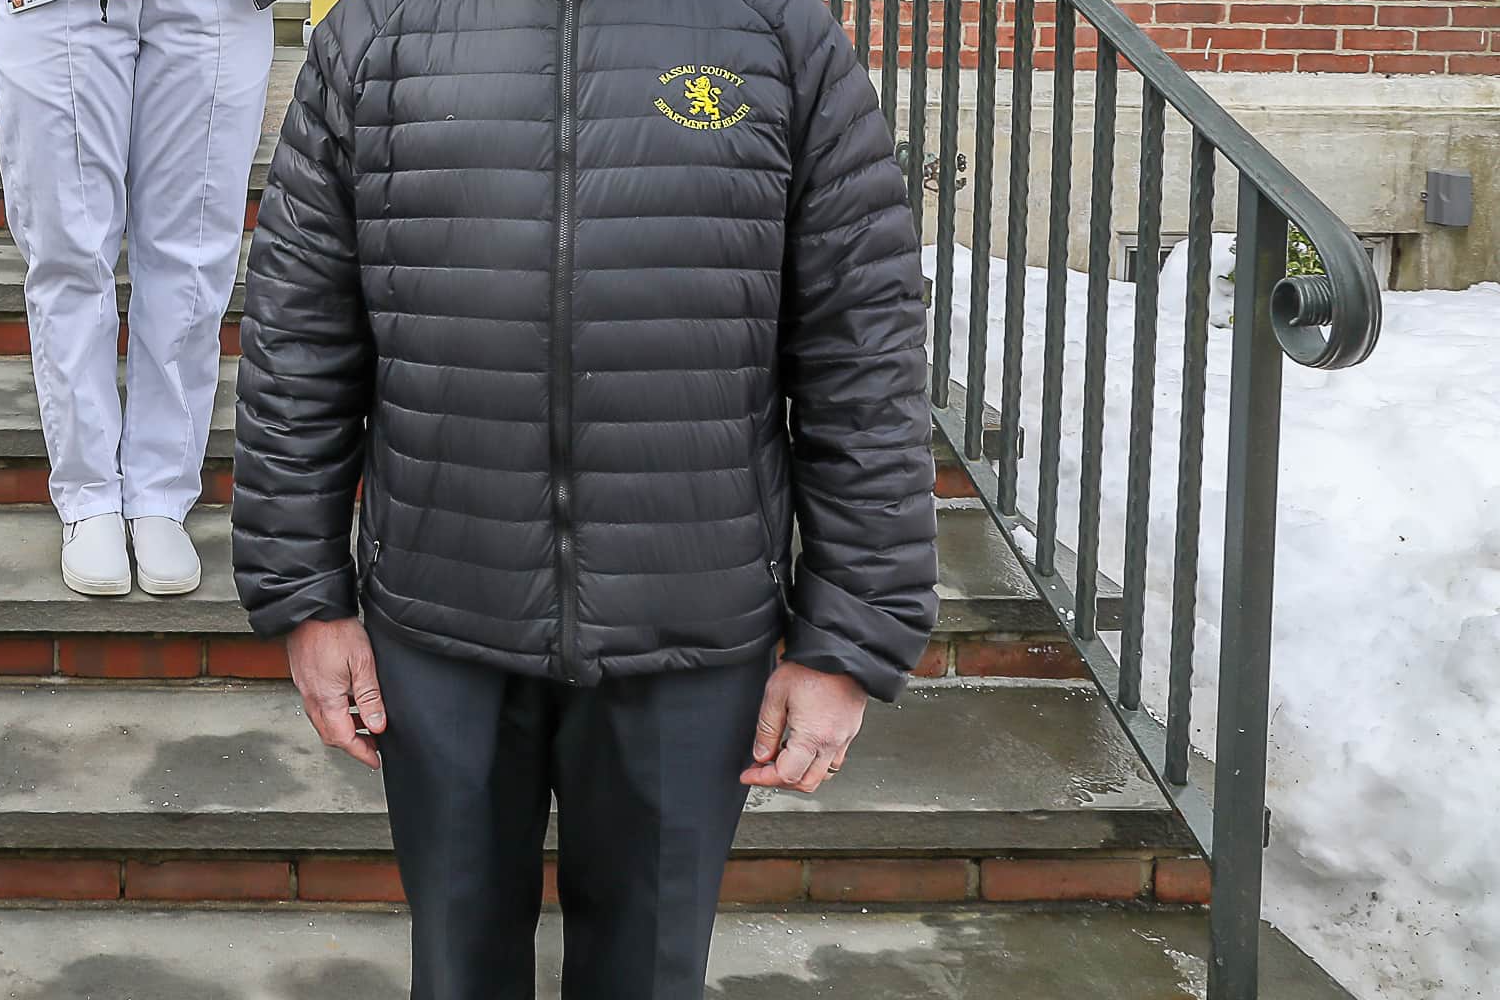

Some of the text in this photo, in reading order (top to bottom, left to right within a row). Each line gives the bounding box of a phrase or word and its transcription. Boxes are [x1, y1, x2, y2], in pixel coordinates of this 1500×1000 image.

[658, 64, 746, 88] NASSAU COUNTY
[653, 97, 752, 131] DEPARTMENT OF HEALTH
